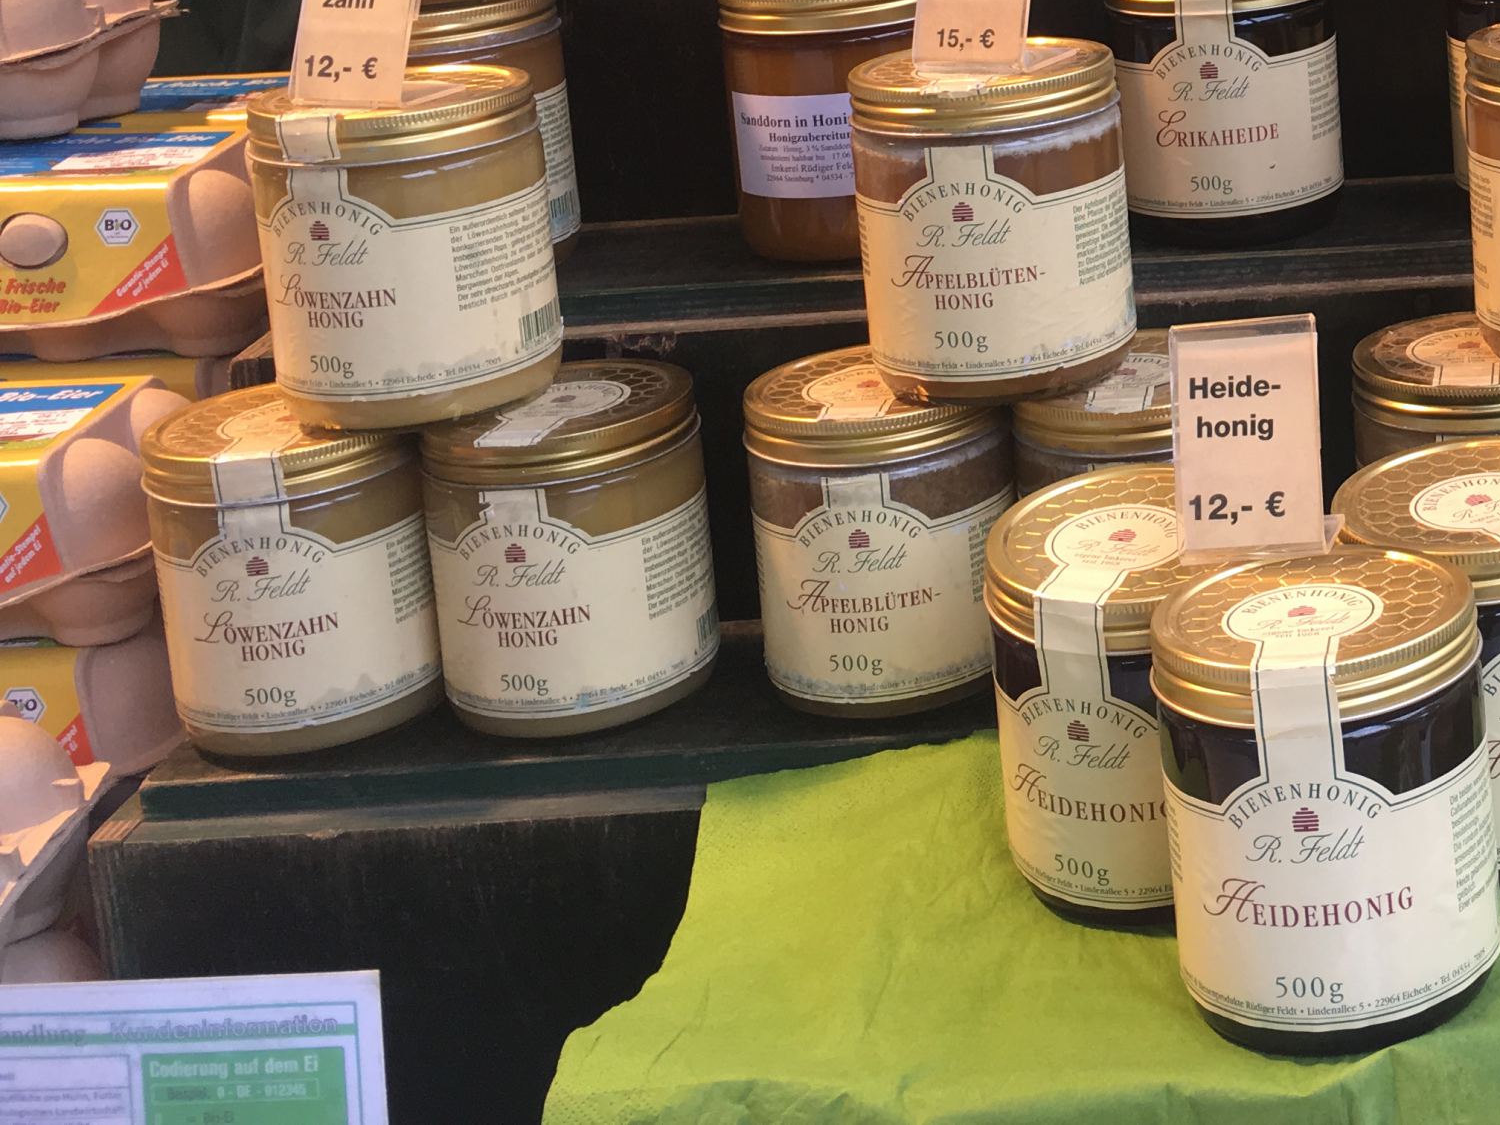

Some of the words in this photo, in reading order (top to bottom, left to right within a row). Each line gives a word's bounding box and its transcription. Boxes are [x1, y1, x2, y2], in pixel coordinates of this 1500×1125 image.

[936, 28, 973, 51] 15,-
[979, 29, 995, 49] €
[304, 55, 352, 84] 12,-
[362, 57, 378, 79] €
[1156, 109, 1279, 148] ERIKAHEIDE
[935, 292, 994, 310] HONIG
[1189, 376, 1281, 398] Heide-
[1196, 415, 1275, 440] honig
[1189, 493, 1253, 525] 12,-
[1265, 491, 1286, 517] €
[498, 629, 558, 649] HONIG
[1229, 783, 1383, 830] BIENENHONIG
[1291, 826, 1366, 864] Feldt
[1204, 878, 1414, 928] HEIDEHONIG
[1275, 976, 1344, 1003] 500g
[1307, 1003, 1354, 1016] Lindenallee
[1359, 1002, 1365, 1012] 5
[1374, 995, 1401, 1008] 22964
[1402, 984, 1433, 1003] Eichede
